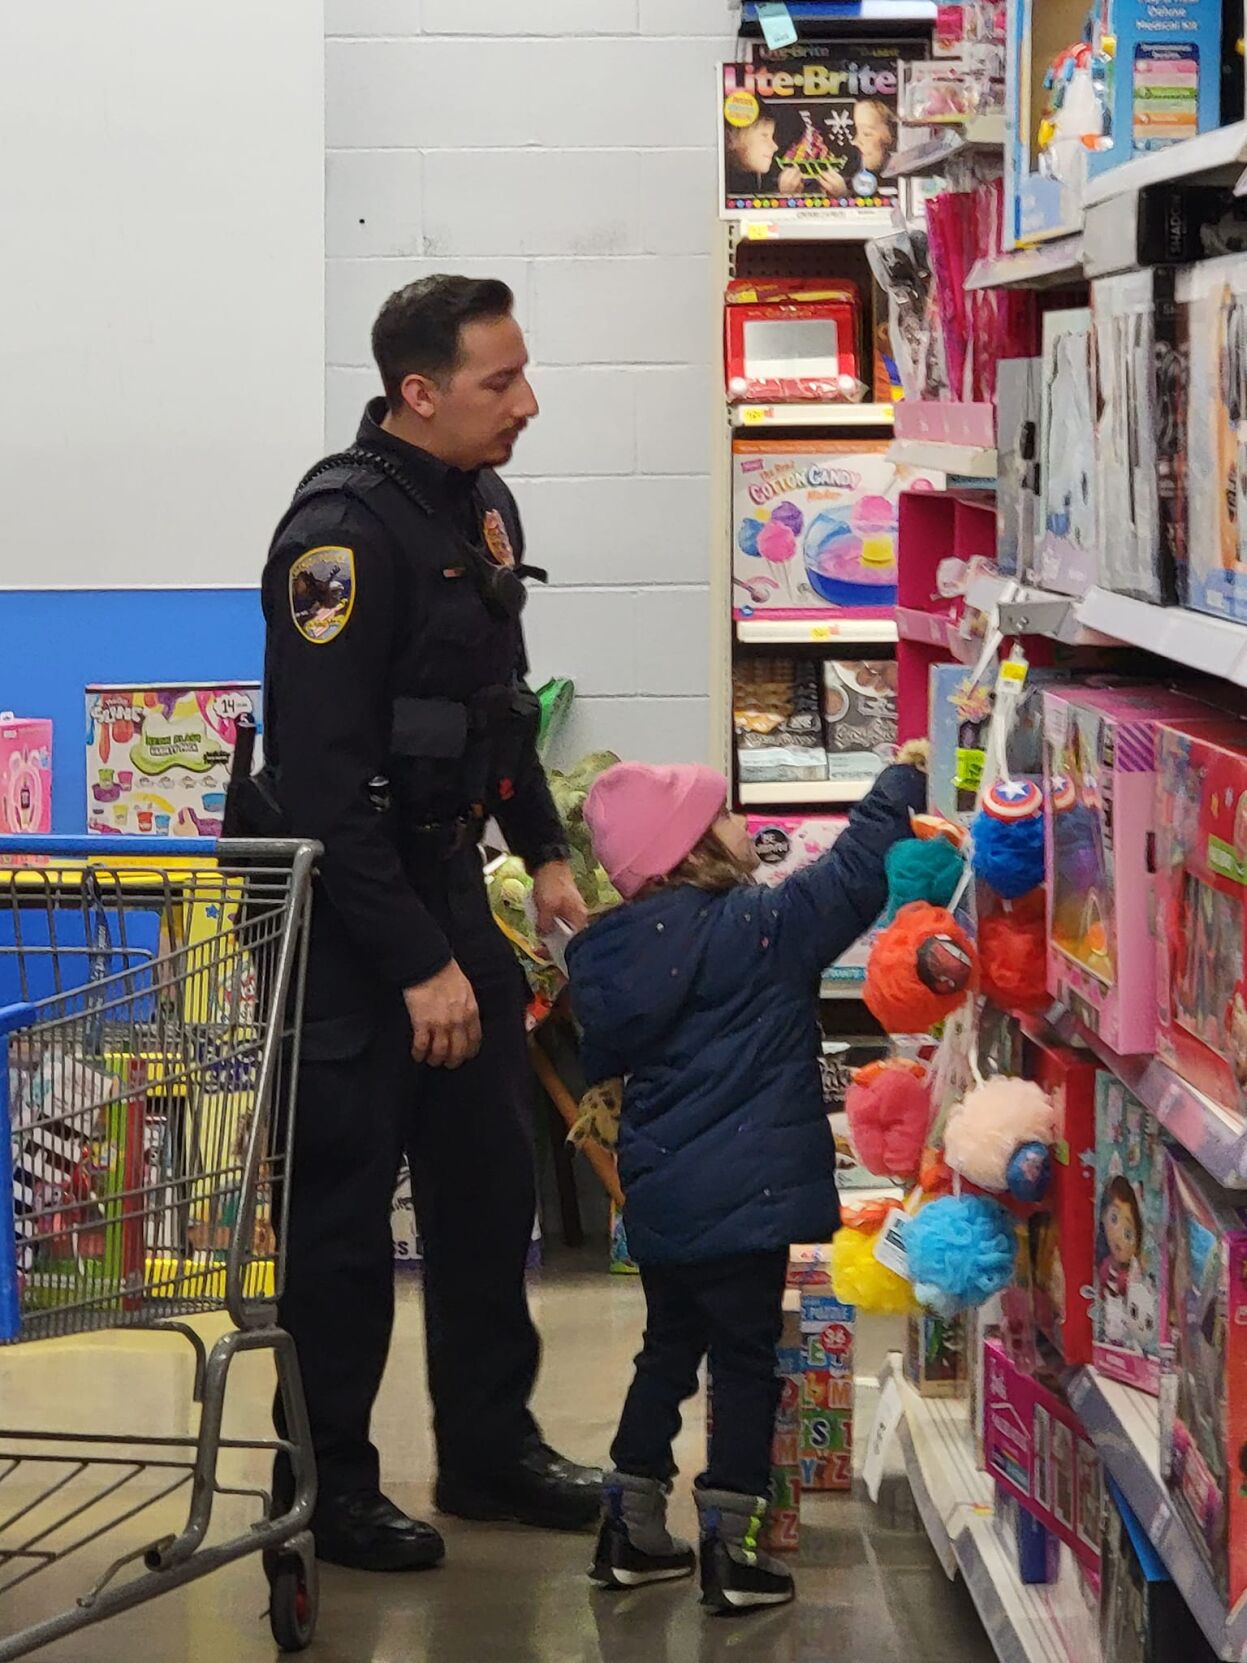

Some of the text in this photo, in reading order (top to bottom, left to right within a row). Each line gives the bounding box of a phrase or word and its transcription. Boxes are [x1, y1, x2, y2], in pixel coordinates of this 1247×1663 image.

[748, 463, 864, 505] COTTON CANDY
[221, 699, 235, 714] 14
